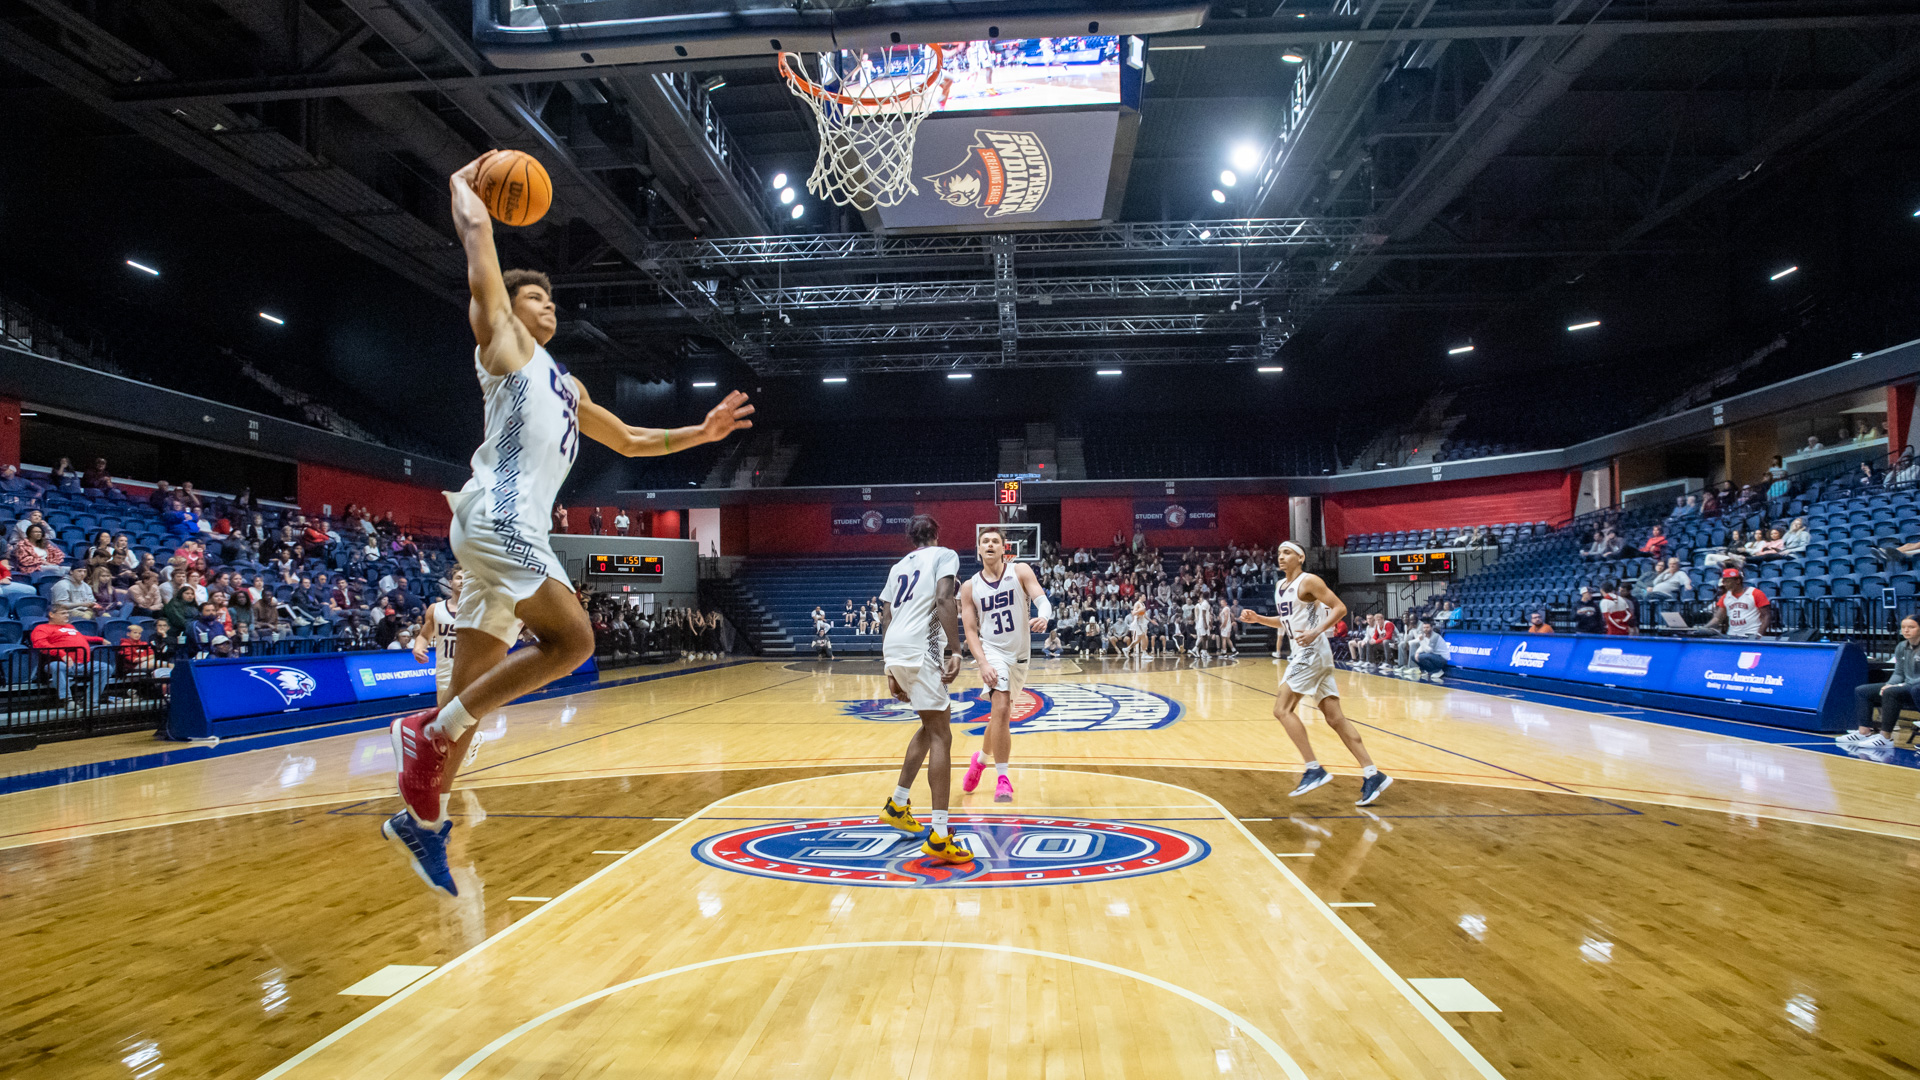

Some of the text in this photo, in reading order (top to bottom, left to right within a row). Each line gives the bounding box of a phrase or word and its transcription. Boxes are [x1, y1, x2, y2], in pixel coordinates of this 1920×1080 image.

[982, 151, 1002, 203] SCREAMING EAGLES
[985, 133, 1028, 215] INDIANA
[1011, 134, 1046, 212] SOUTHERN
[1431, 466, 1442, 474] 207
[1004, 481, 1019, 490] 1:55
[1000, 489, 1016, 503] 30
[623, 556, 639, 565] 1:55
[1407, 554, 1424, 563] 1:55
[600, 562, 606, 571] 0
[655, 563, 661, 573] 0
[1383, 562, 1390, 572] 0
[893, 569, 921, 609] 22
[980, 588, 1015, 612] USI
[991, 609, 1015, 635] 33
[1458, 646, 1478, 655] NATIONAL
[1478, 647, 1493, 656] BANK
[375, 671, 394, 681] DUNN
[394, 668, 427, 680] HOSPITALITY
[1704, 670, 1785, 686] German American Bank
[793, 818, 1126, 831] CONFENCE
[807, 832, 1094, 858] OVC
[717, 850, 1161, 881] OHIO VALLEY
